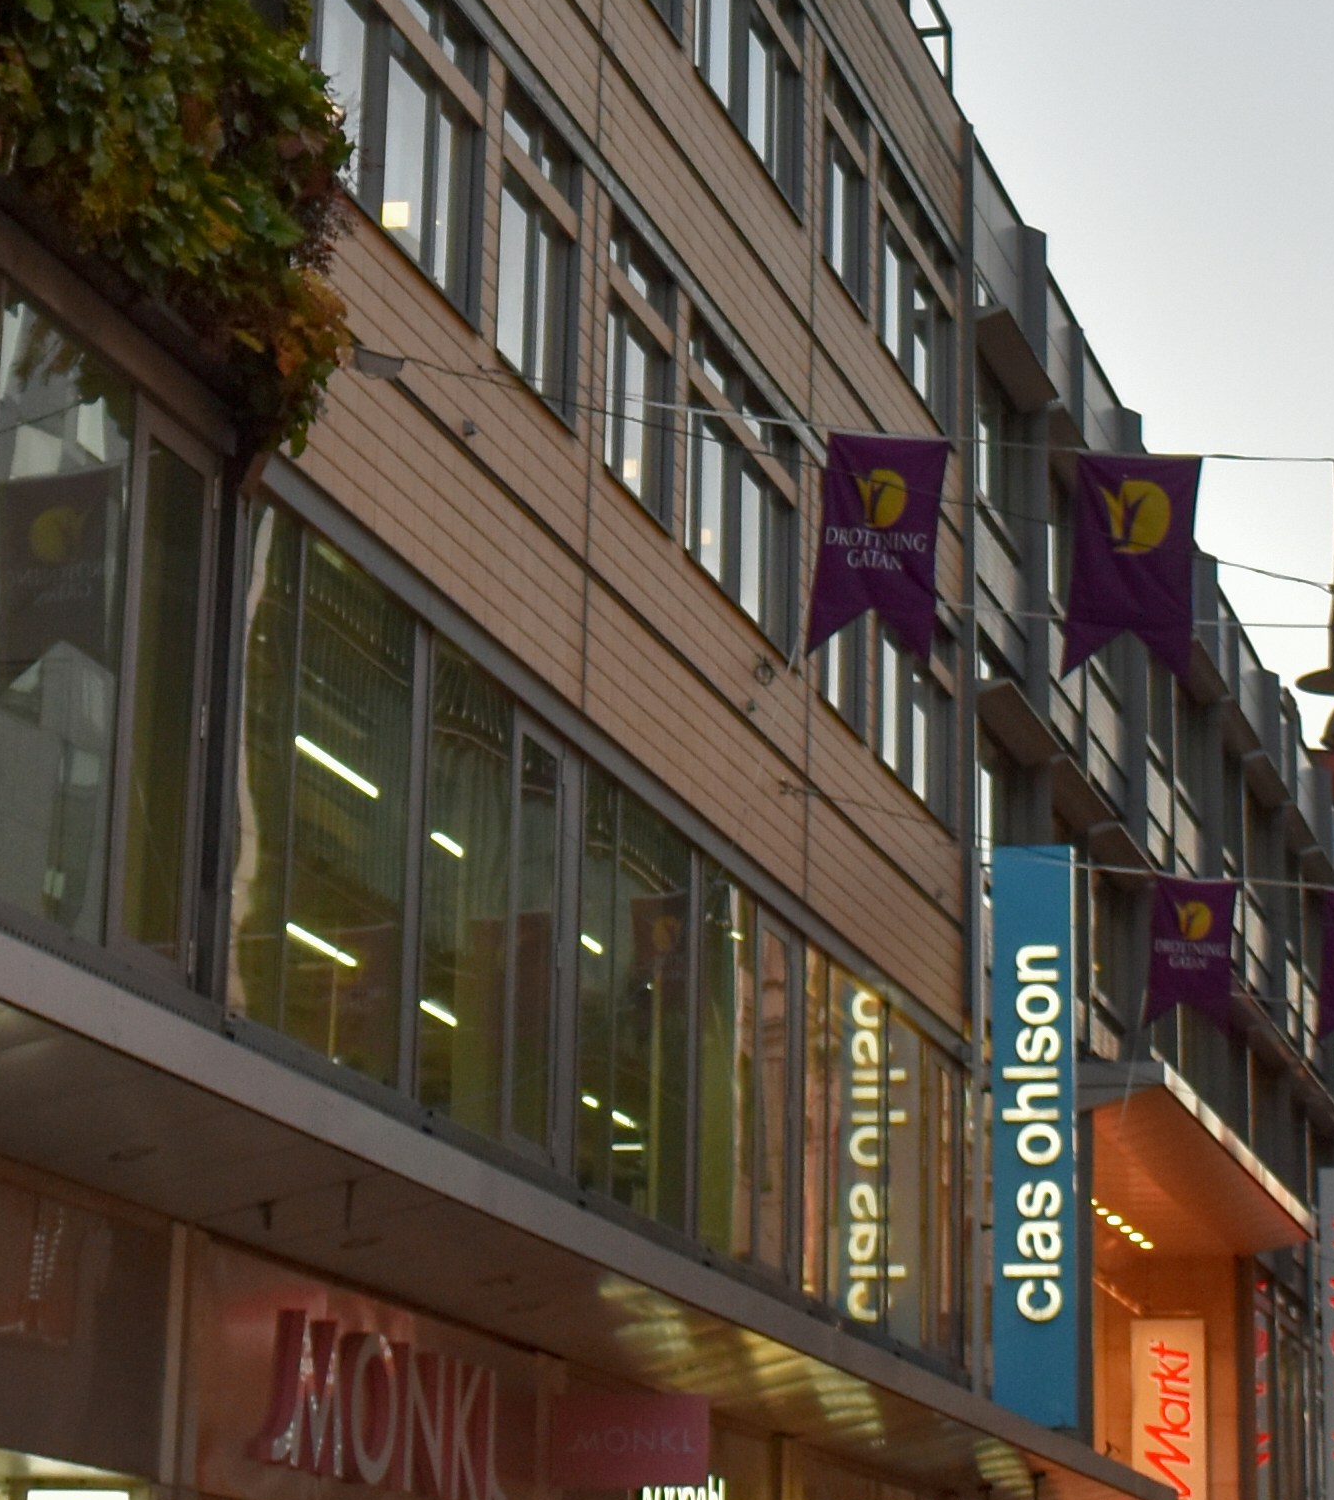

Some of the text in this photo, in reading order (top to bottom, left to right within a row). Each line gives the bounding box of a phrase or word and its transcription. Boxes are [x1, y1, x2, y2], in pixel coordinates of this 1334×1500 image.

[824, 525, 928, 552] DROTTNING
[846, 549, 902, 571] GATAN
[1153, 937, 1227, 957] DROTTNING
[1002, 943, 1063, 1323] clas ohlson
[1143, 1339, 1192, 1497] Markt
